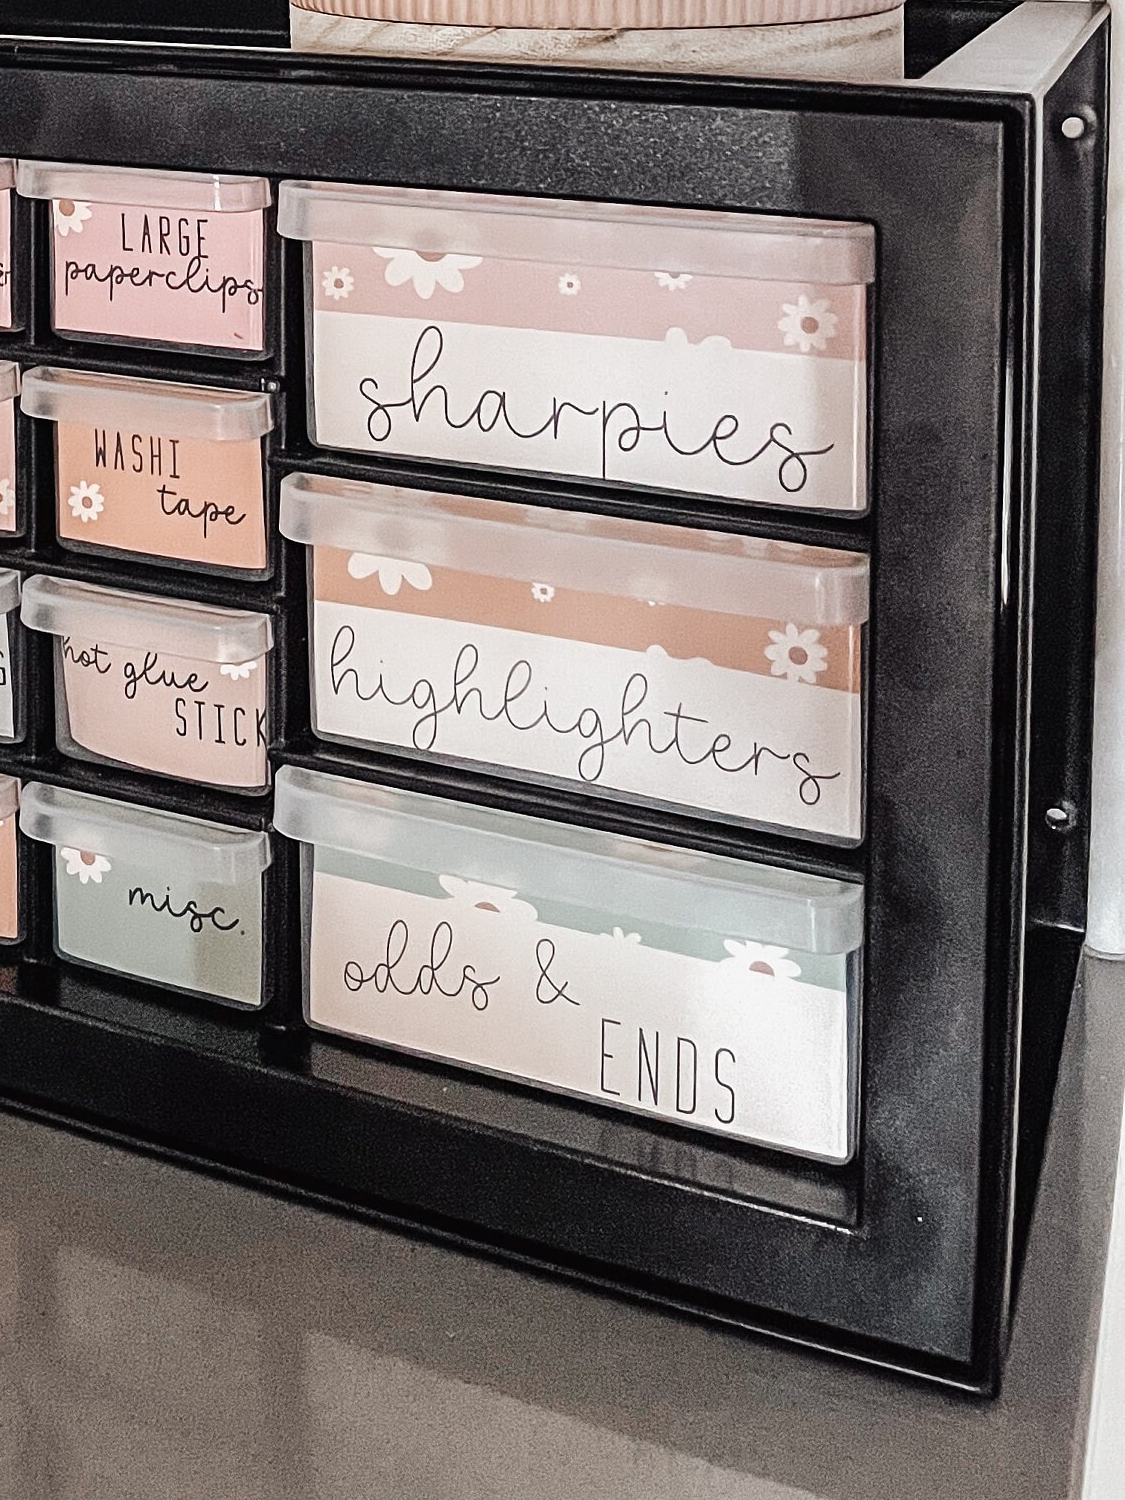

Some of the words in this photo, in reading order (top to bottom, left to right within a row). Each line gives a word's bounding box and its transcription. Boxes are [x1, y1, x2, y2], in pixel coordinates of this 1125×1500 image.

[121, 212, 209, 258] LARGE
[65, 256, 263, 312] paperclips
[359, 325, 834, 492] sharpies
[93, 428, 181, 479] WASHI
[156, 484, 246, 538] tape
[62, 636, 112, 674] hot
[124, 652, 209, 699] glue
[175, 697, 267, 748] STICK
[329, 625, 841, 806] highlighters
[128, 886, 246, 936] misc.
[344, 919, 500, 1011] odds
[535, 938, 581, 1007] &
[599, 1017, 736, 1124] ENDS
